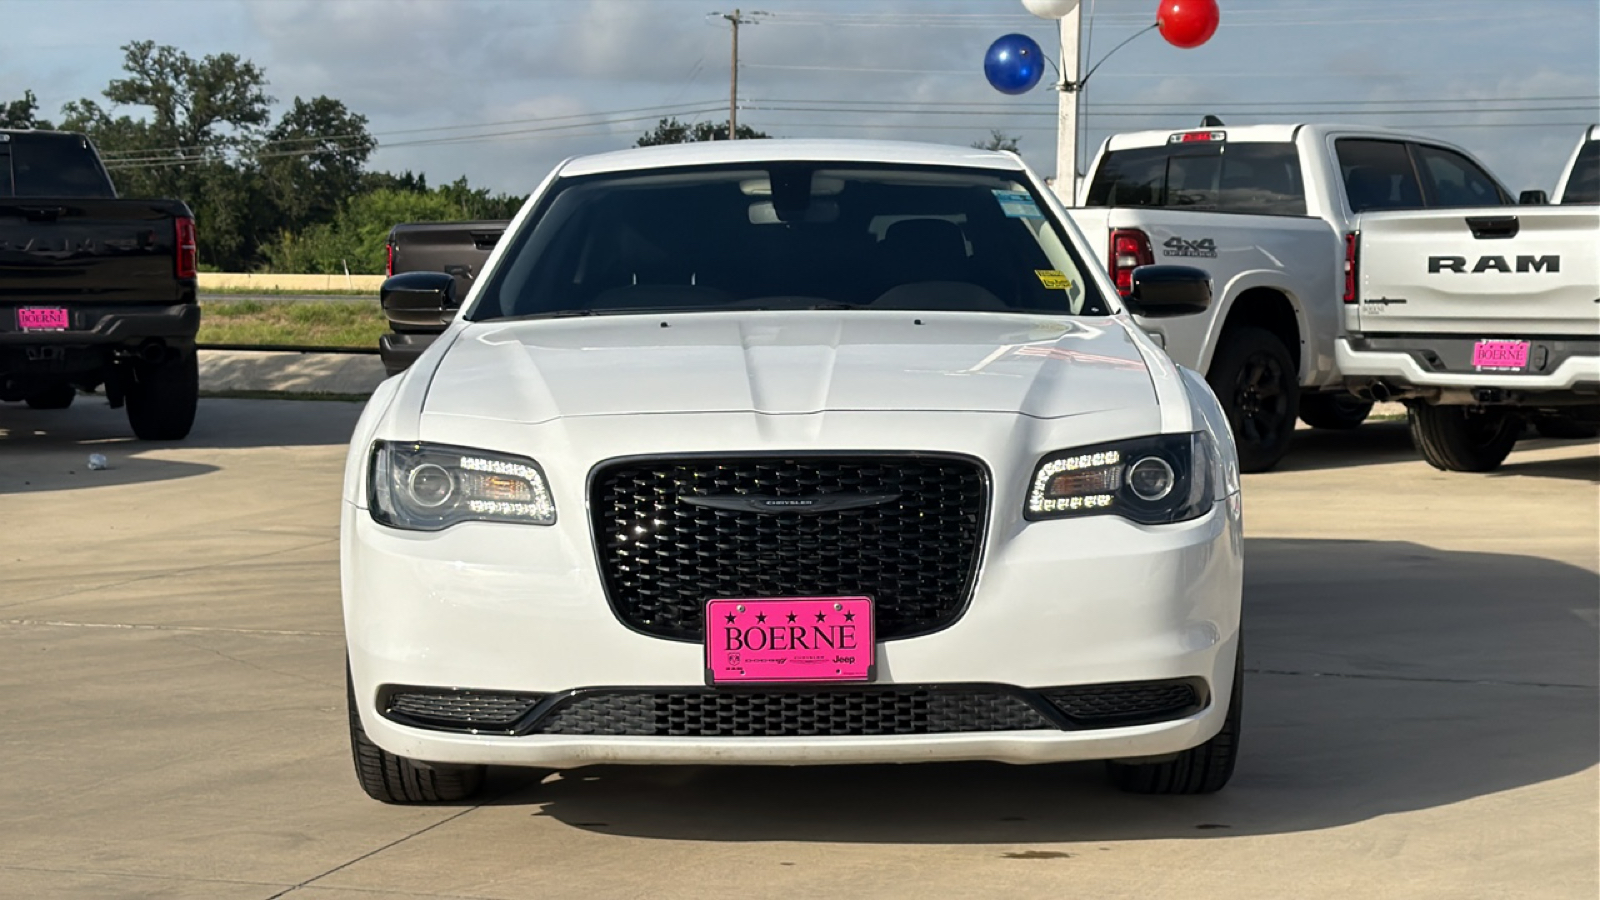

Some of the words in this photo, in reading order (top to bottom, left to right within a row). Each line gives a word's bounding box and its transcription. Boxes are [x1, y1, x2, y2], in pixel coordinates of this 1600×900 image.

[1163, 236, 1218, 251] 4x4
[1428, 255, 1560, 274] RAM
[1478, 349, 1523, 361] BOERNE
[724, 625, 857, 651] BOERNE
[832, 655, 855, 665] Jeep
